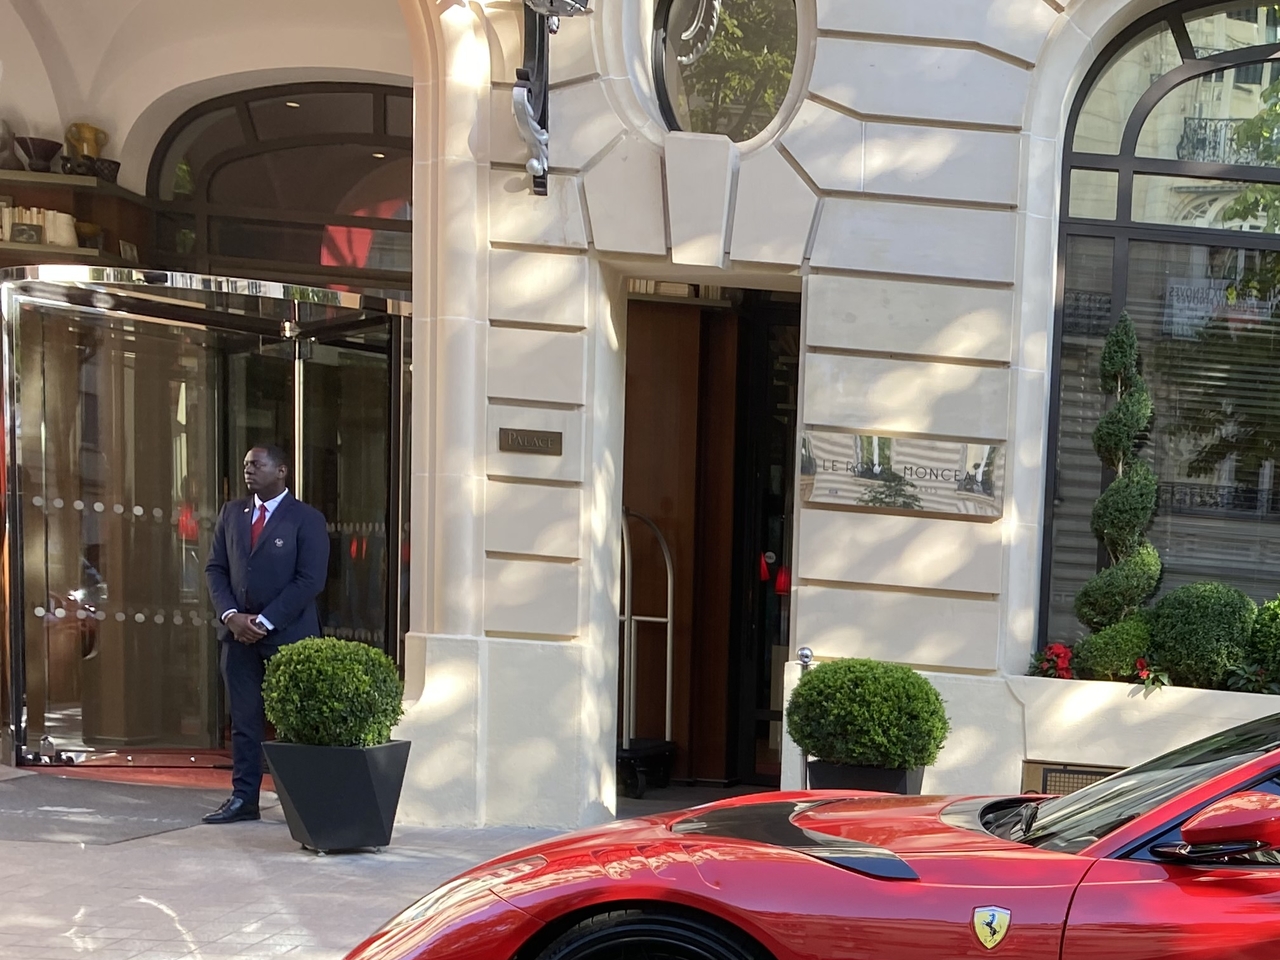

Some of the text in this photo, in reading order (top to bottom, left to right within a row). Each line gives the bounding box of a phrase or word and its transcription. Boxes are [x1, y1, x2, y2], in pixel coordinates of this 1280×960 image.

[507, 430, 553, 448] PALACE
[822, 459, 839, 472] LE
[903, 465, 984, 484] MONCEAU
